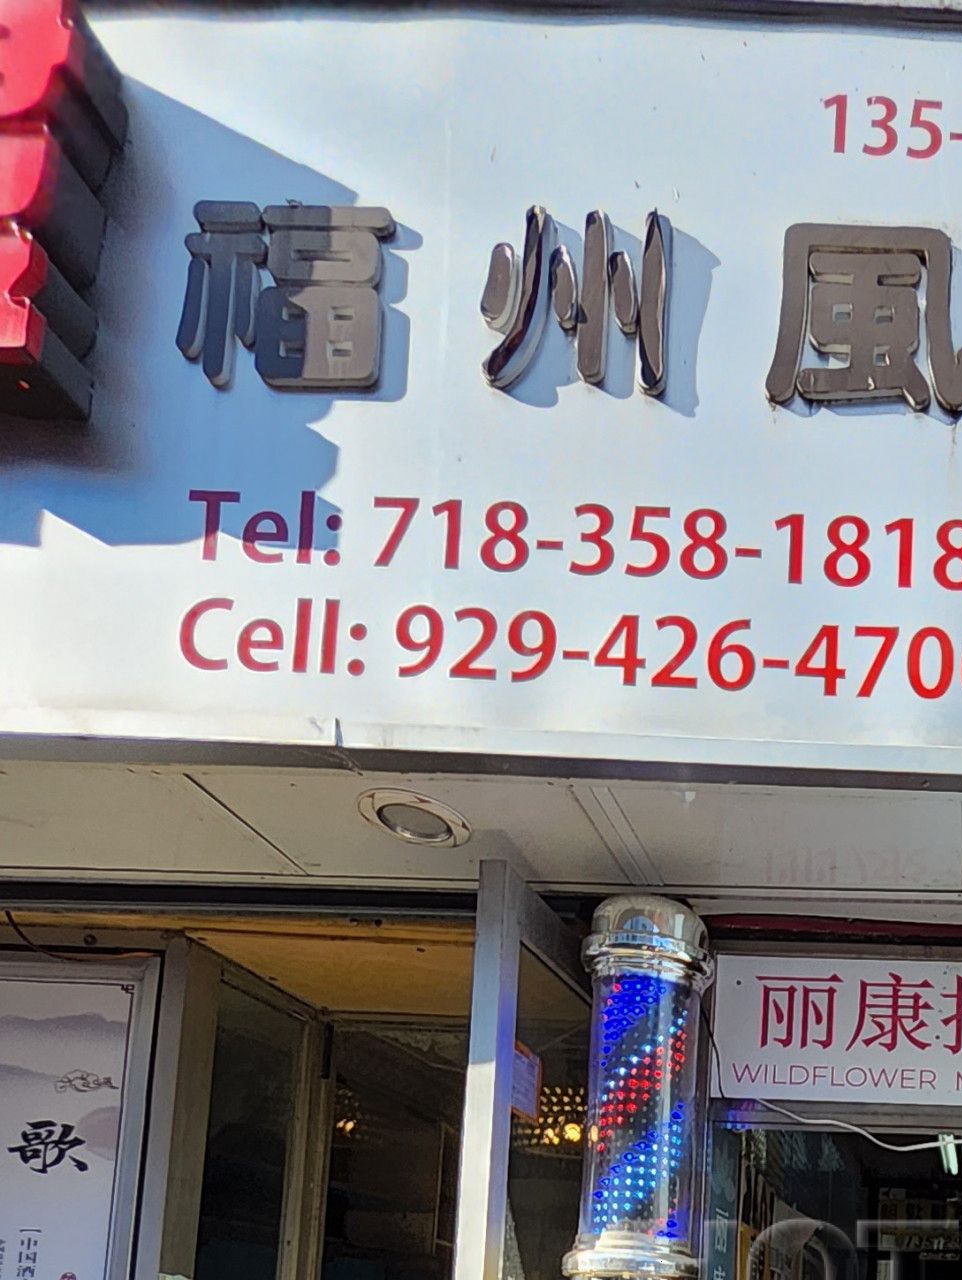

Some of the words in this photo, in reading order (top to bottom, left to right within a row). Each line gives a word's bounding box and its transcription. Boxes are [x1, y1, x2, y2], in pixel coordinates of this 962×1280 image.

[188, 490, 342, 567] Tel:
[178, 597, 366, 677] Cell:
[732, 1063, 937, 1091] WILDFLOWER
[8, 1120, 89, 1174] 歌
